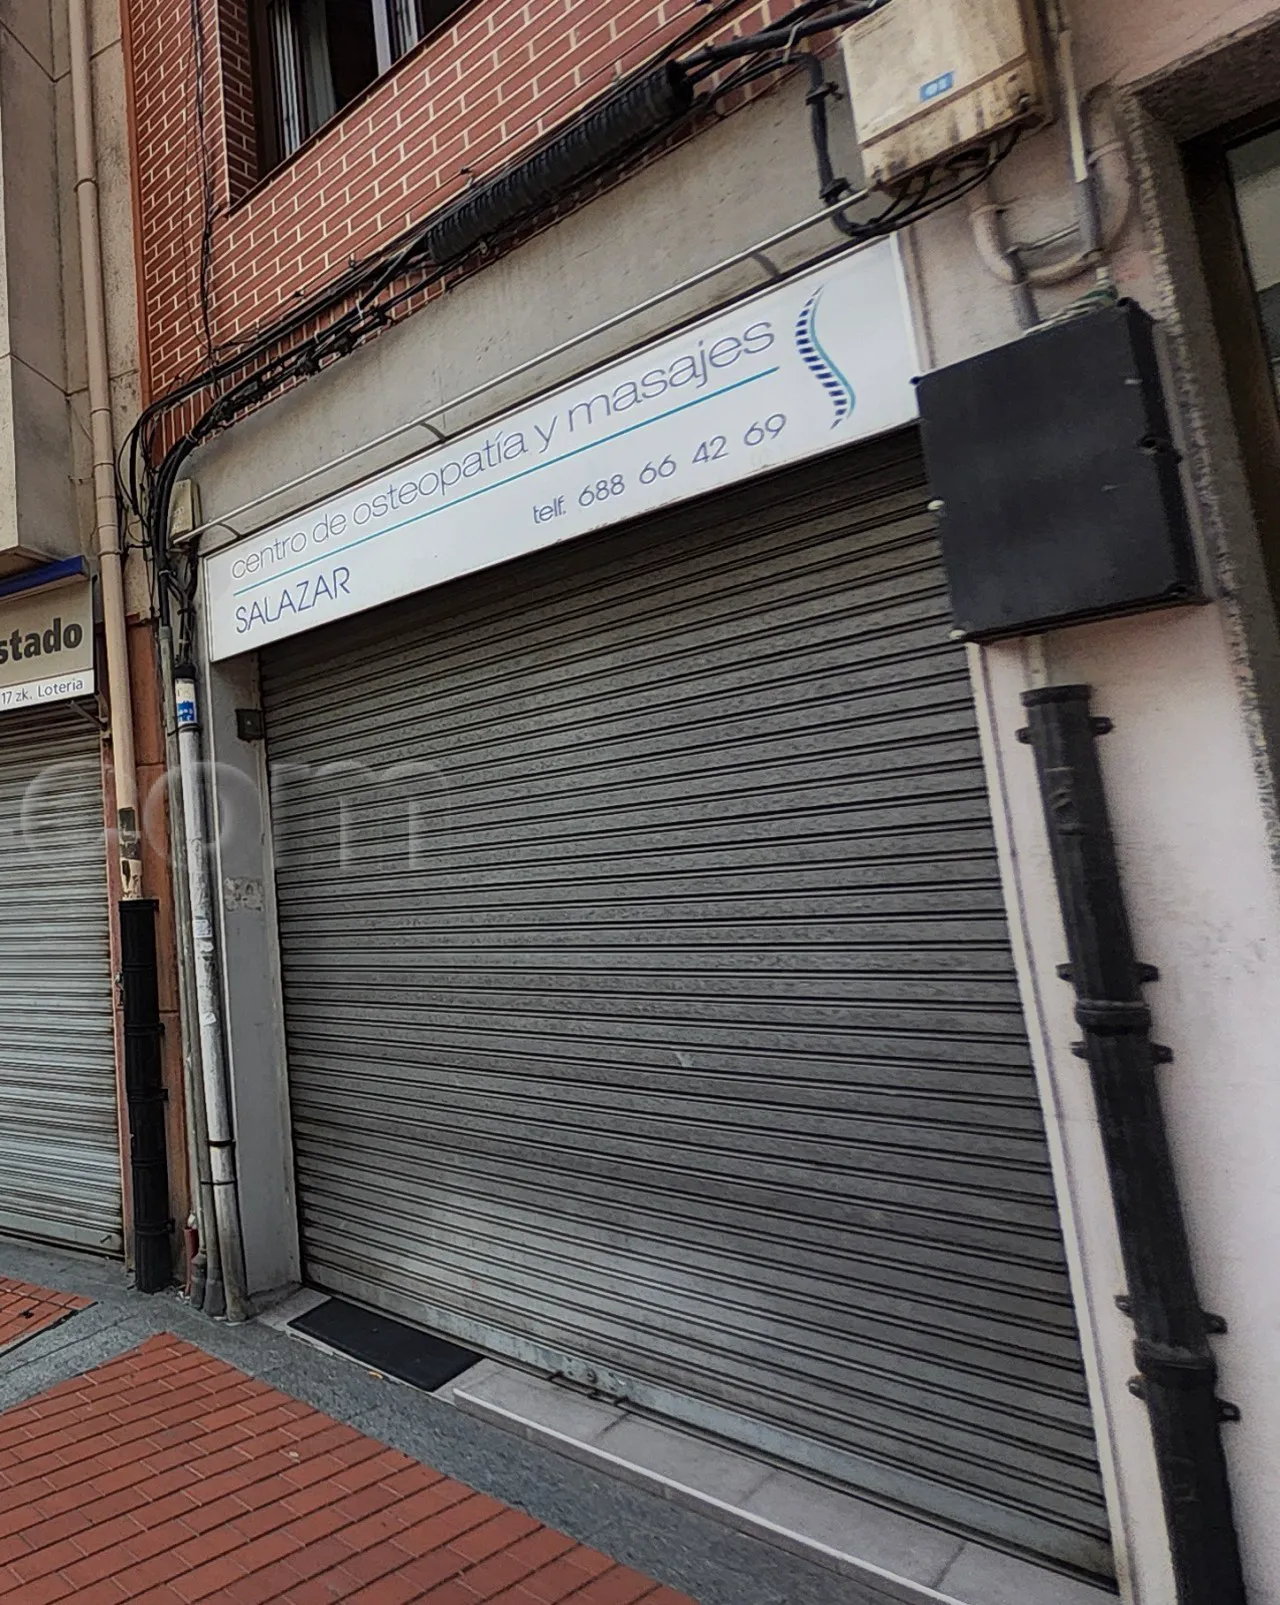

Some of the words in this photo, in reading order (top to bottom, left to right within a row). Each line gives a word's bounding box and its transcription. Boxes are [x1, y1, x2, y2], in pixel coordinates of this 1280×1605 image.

[232, 532, 307, 579] centro
[312, 512, 347, 543] de
[353, 430, 528, 525] osteopatía
[534, 415, 558, 453] y
[568, 321, 775, 432] masajes
[578, 474, 626, 507] 688
[638, 454, 677, 484] 66
[692, 435, 729, 465] 42
[743, 413, 787, 446] 69
[235, 566, 351, 634] SALAZAR
[1, 691, 12, 705] 17
